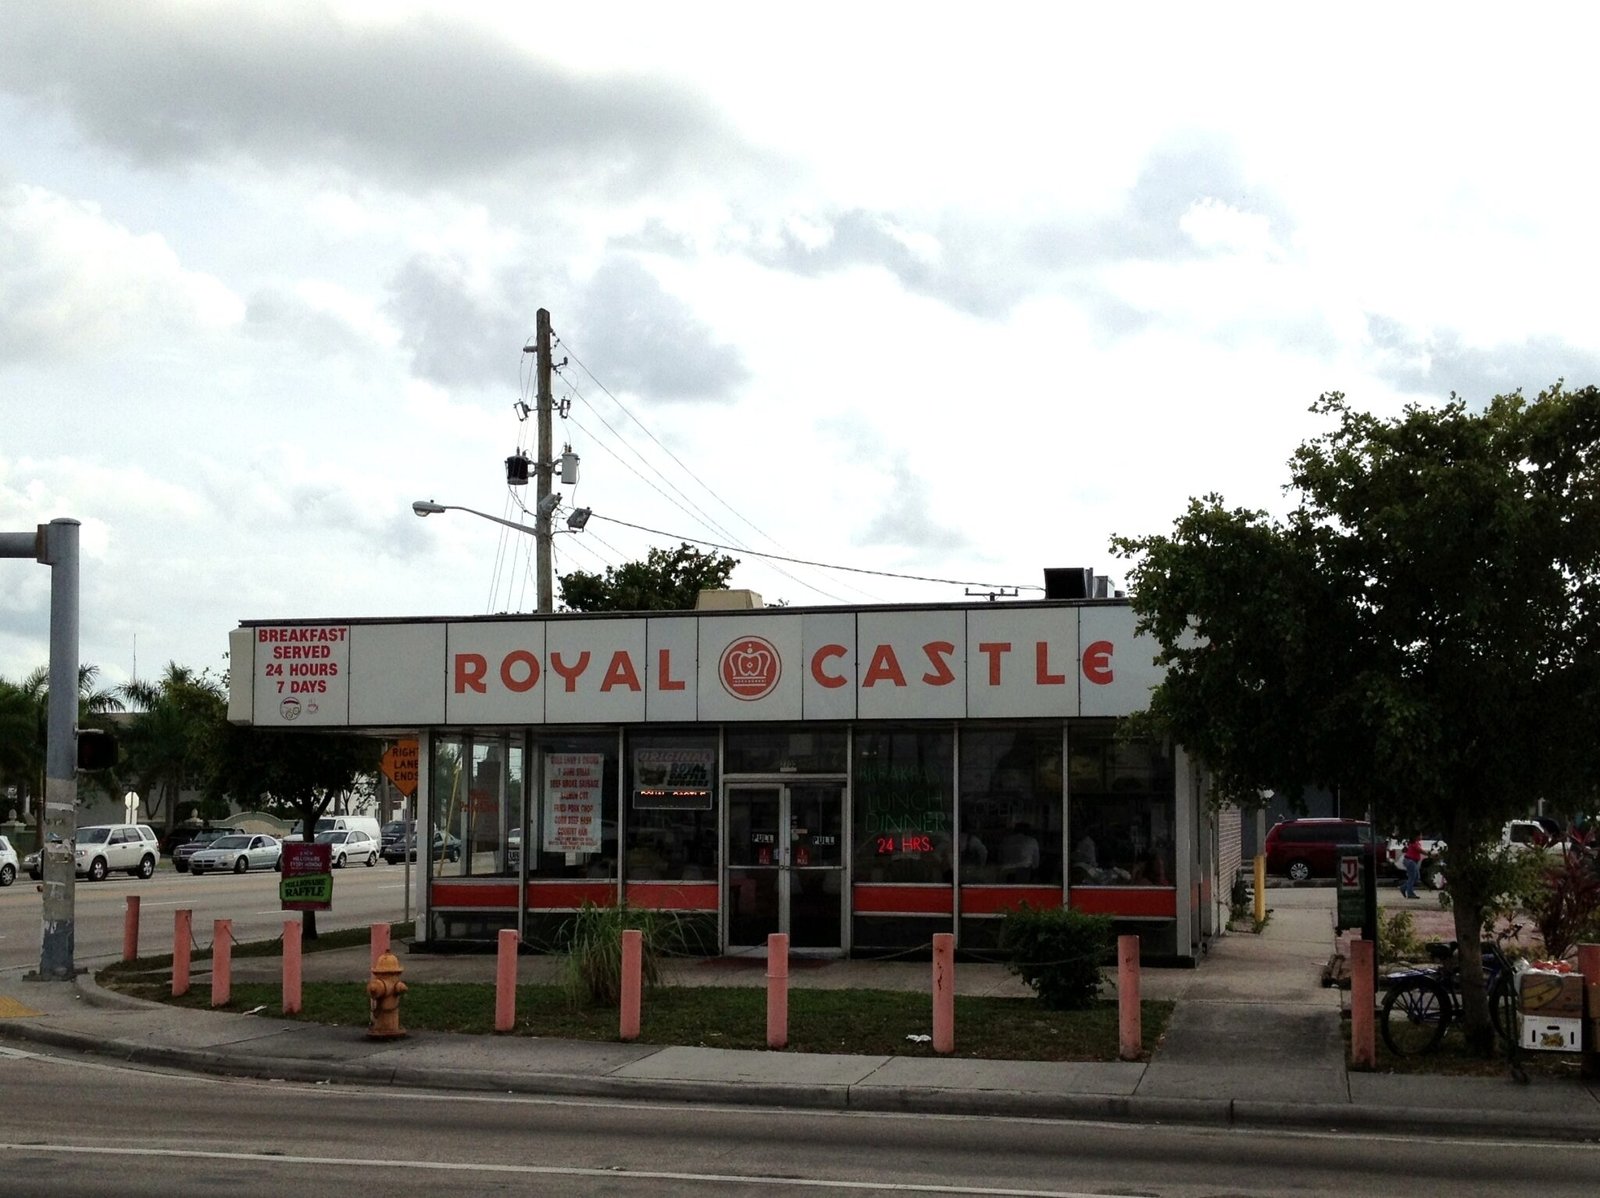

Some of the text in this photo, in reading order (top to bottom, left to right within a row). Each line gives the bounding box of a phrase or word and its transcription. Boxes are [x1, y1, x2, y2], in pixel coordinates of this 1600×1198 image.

[259, 628, 347, 643] BREAKFAST
[273, 645, 331, 659] SERVED
[265, 663, 338, 676] 24 HOURS
[811, 640, 1114, 688] CASTLE
[455, 649, 685, 694] ROYAL
[277, 680, 327, 694] 7 DAYS
[638, 751, 712, 762] ORIGINAL
[394, 760, 418, 769] LANE
[394, 772, 418, 781] ENDS
[864, 811, 946, 832] DINNER
[877, 837, 894, 854] 24
[285, 886, 325, 898] RAFFLE
